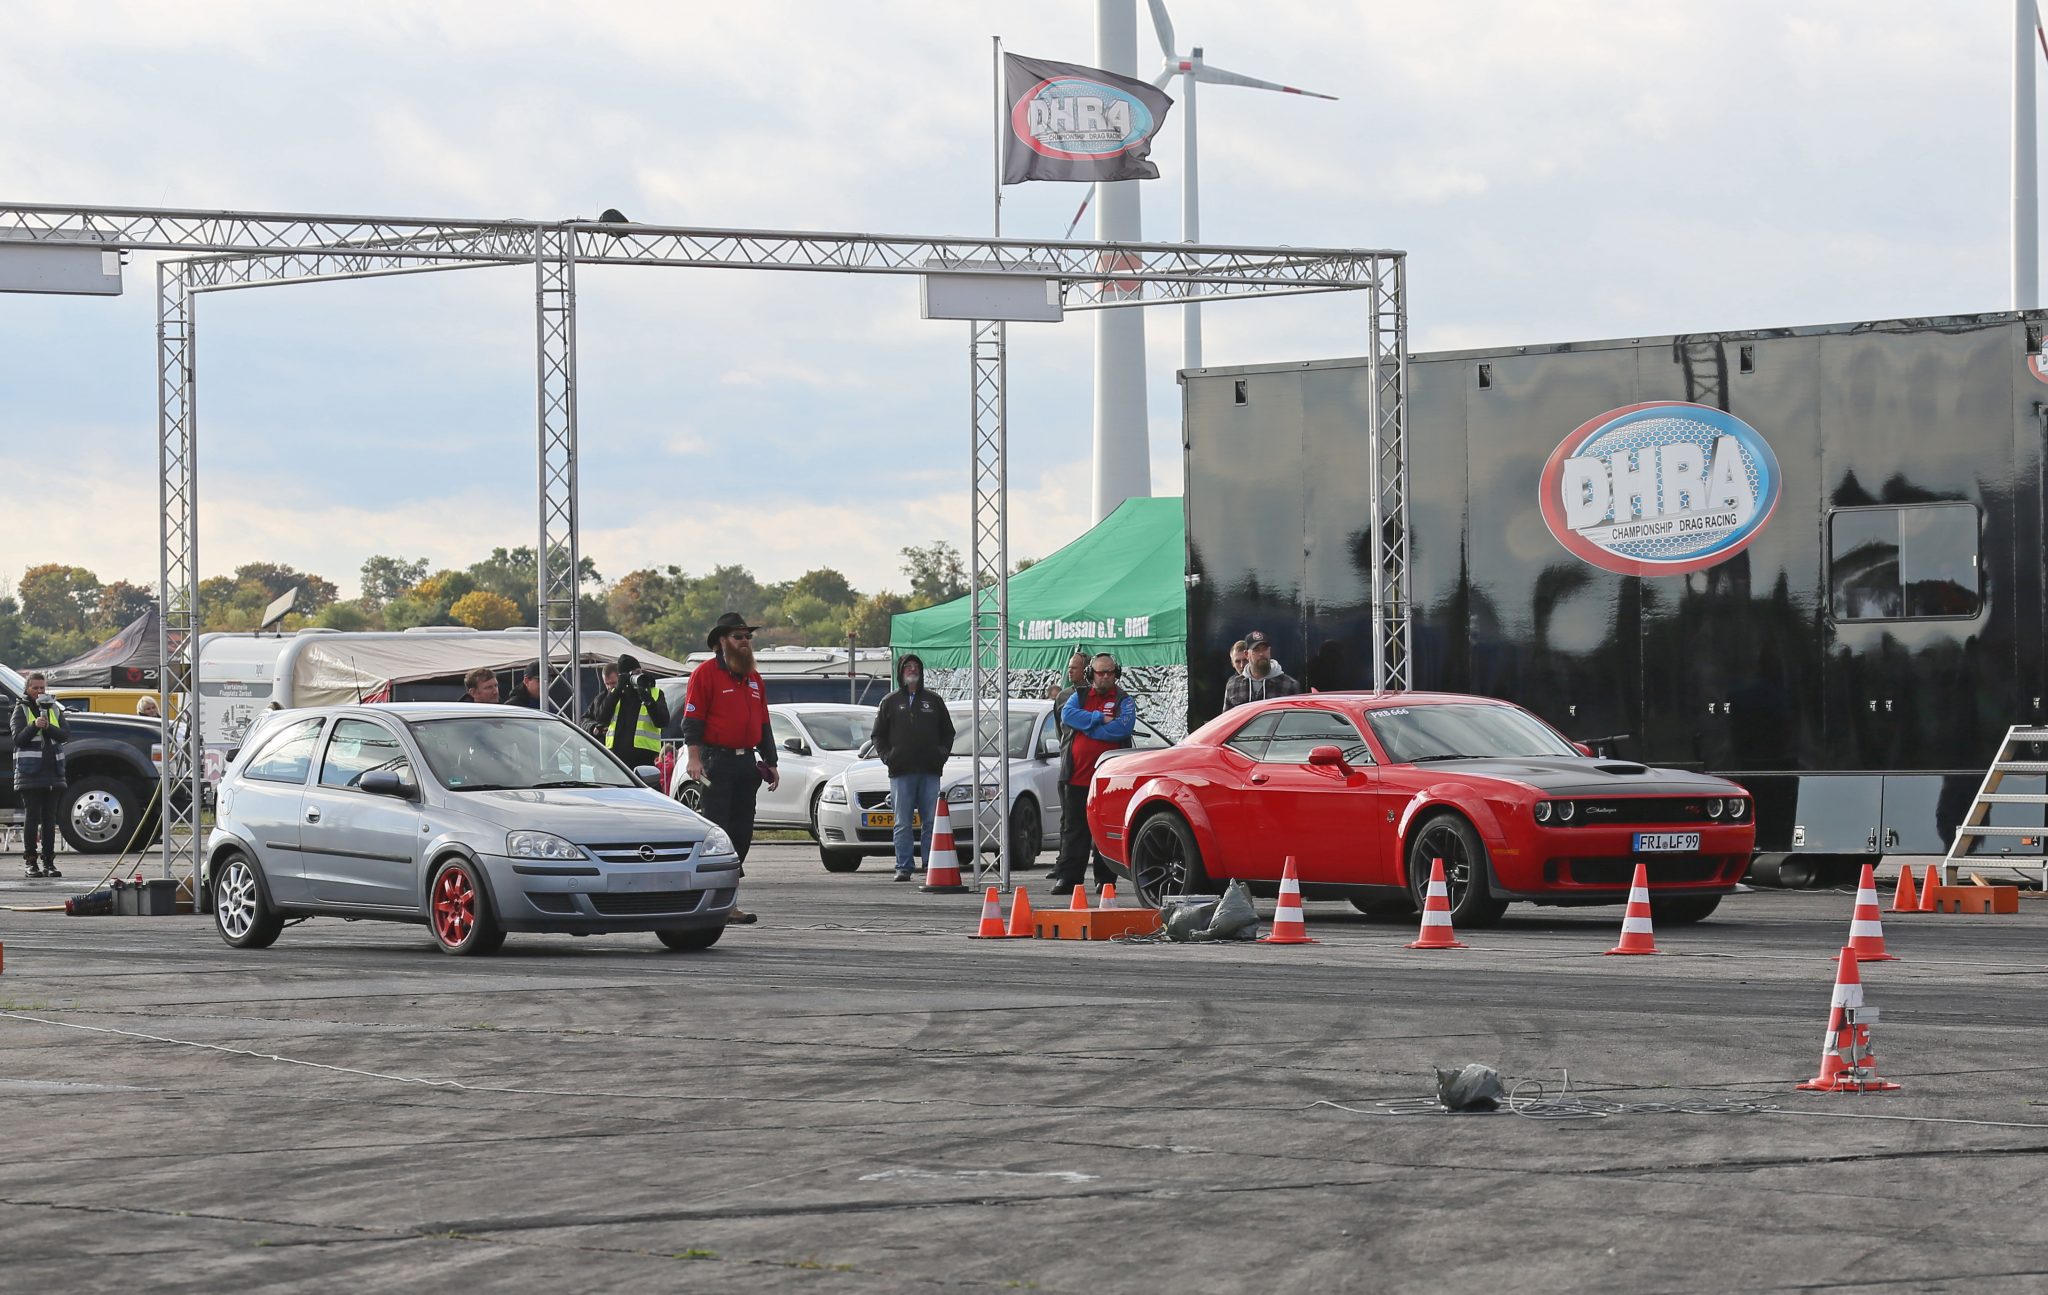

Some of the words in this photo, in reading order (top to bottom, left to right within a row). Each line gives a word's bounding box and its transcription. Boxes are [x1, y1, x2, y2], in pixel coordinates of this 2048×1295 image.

[1030, 96, 1130, 136] DHRA
[1563, 435, 1755, 530] DHRA
[1612, 521, 1673, 540] CHAMPIONSHIP
[1679, 517, 1703, 532] DRAG
[1705, 513, 1737, 530] RACING
[1027, 620, 1052, 641] AMC
[1054, 619, 1096, 640] Dessau
[1125, 616, 1149, 638] DMV
[1390, 708, 1409, 716] 666
[1640, 835, 1661, 849] FRI
[1669, 835, 1684, 849] LF
[1685, 834, 1699, 849] 99
